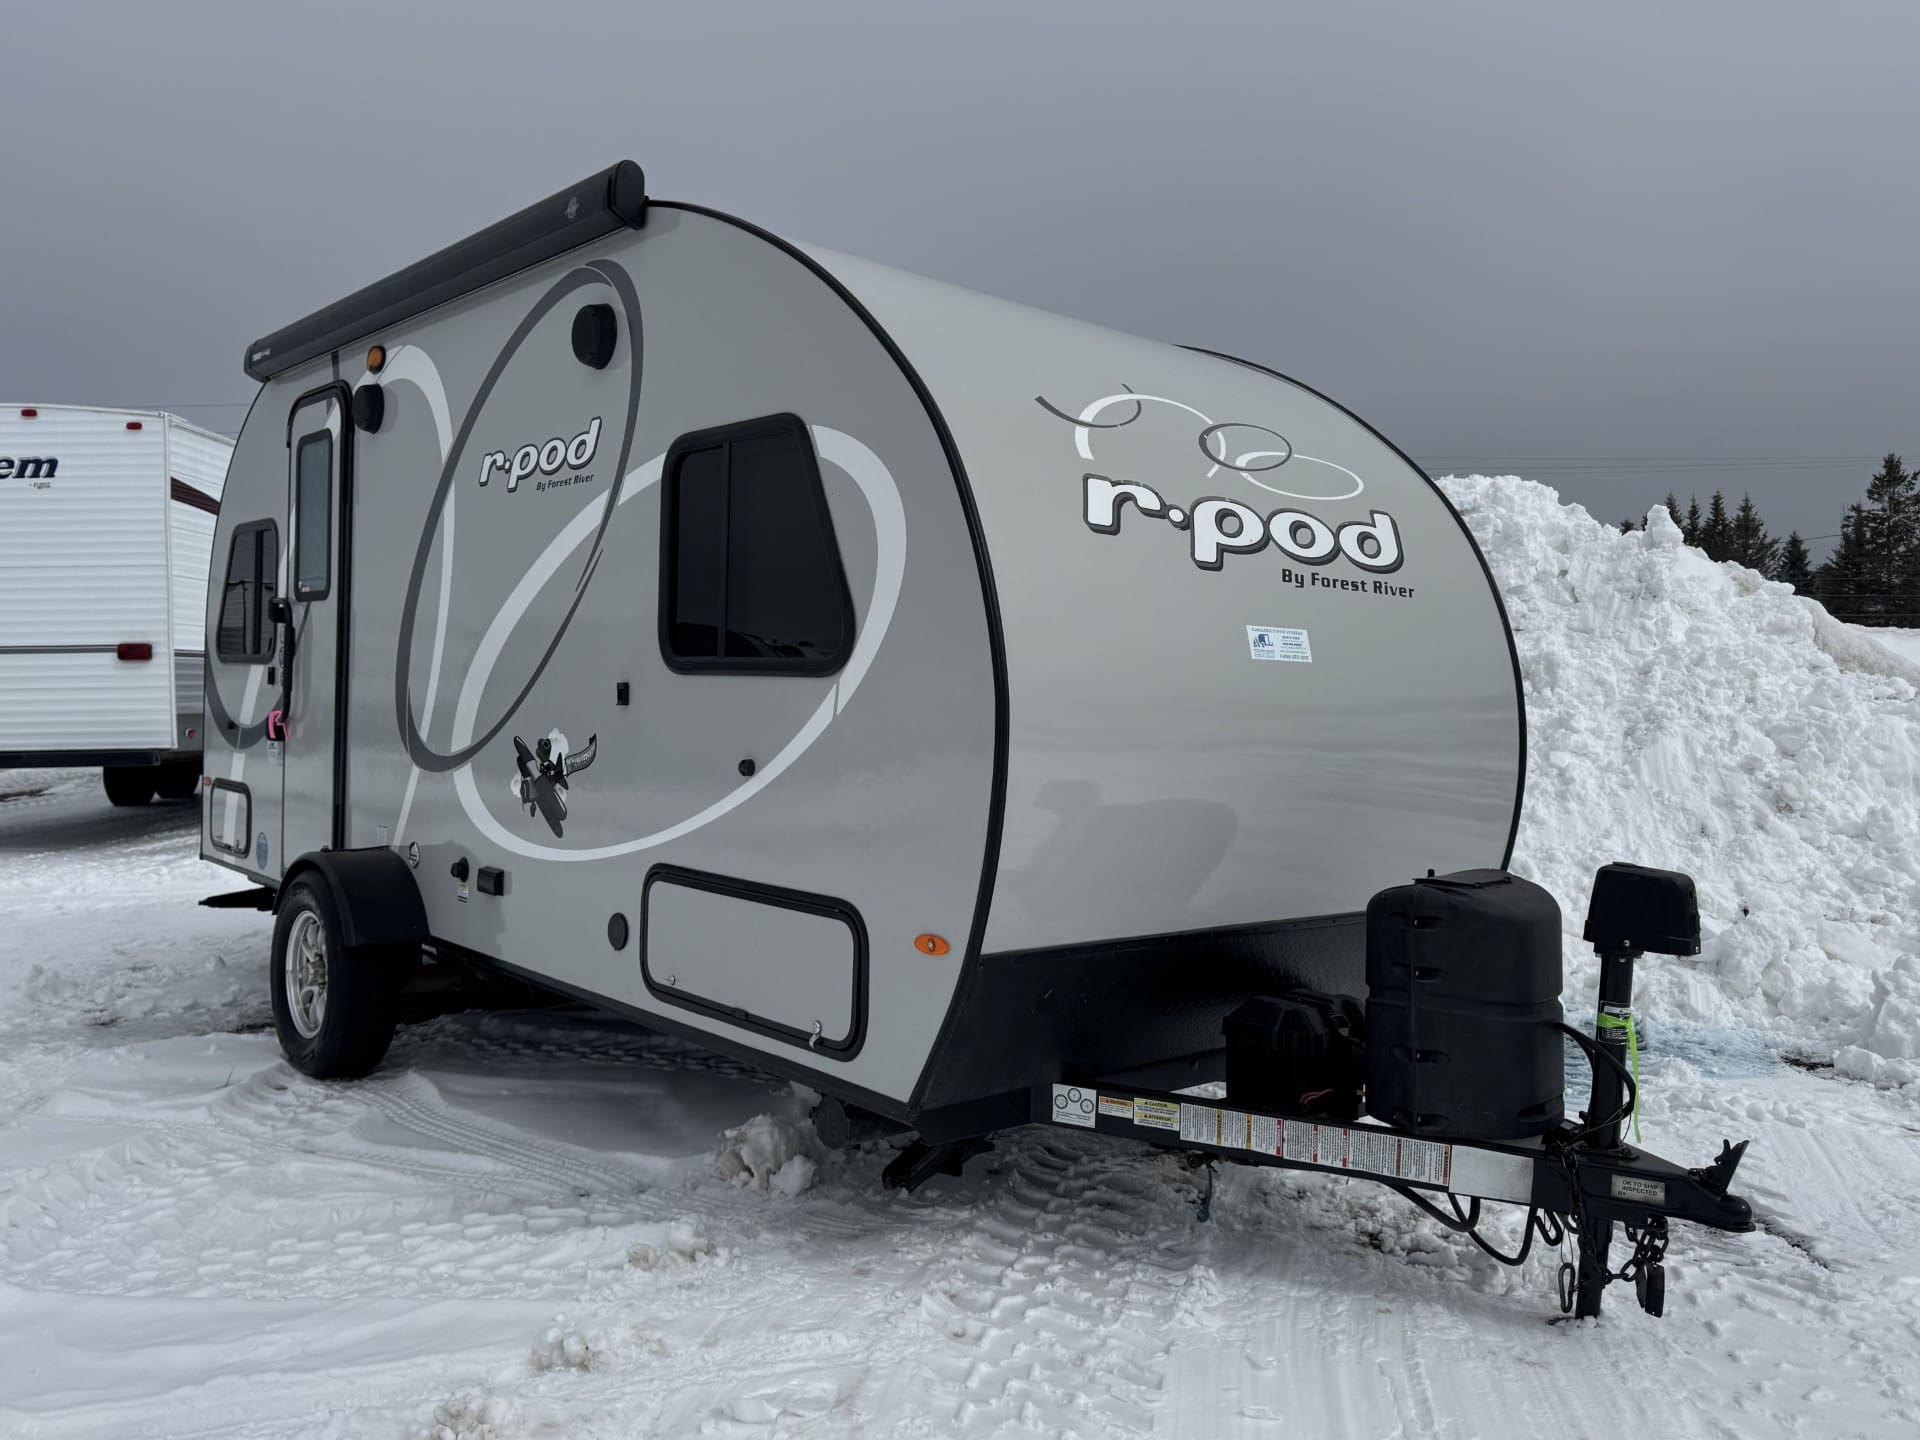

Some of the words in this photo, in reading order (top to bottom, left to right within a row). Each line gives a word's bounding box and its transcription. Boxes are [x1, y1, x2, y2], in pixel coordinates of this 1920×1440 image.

[536, 481, 547, 493] By
[547, 477, 572, 489] Forest
[574, 474, 594, 485] River
[1281, 568, 1305, 588] By
[1311, 572, 1368, 592] Forest
[1373, 580, 1415, 598] River
[1621, 1185, 1658, 1196] INSPECTED
